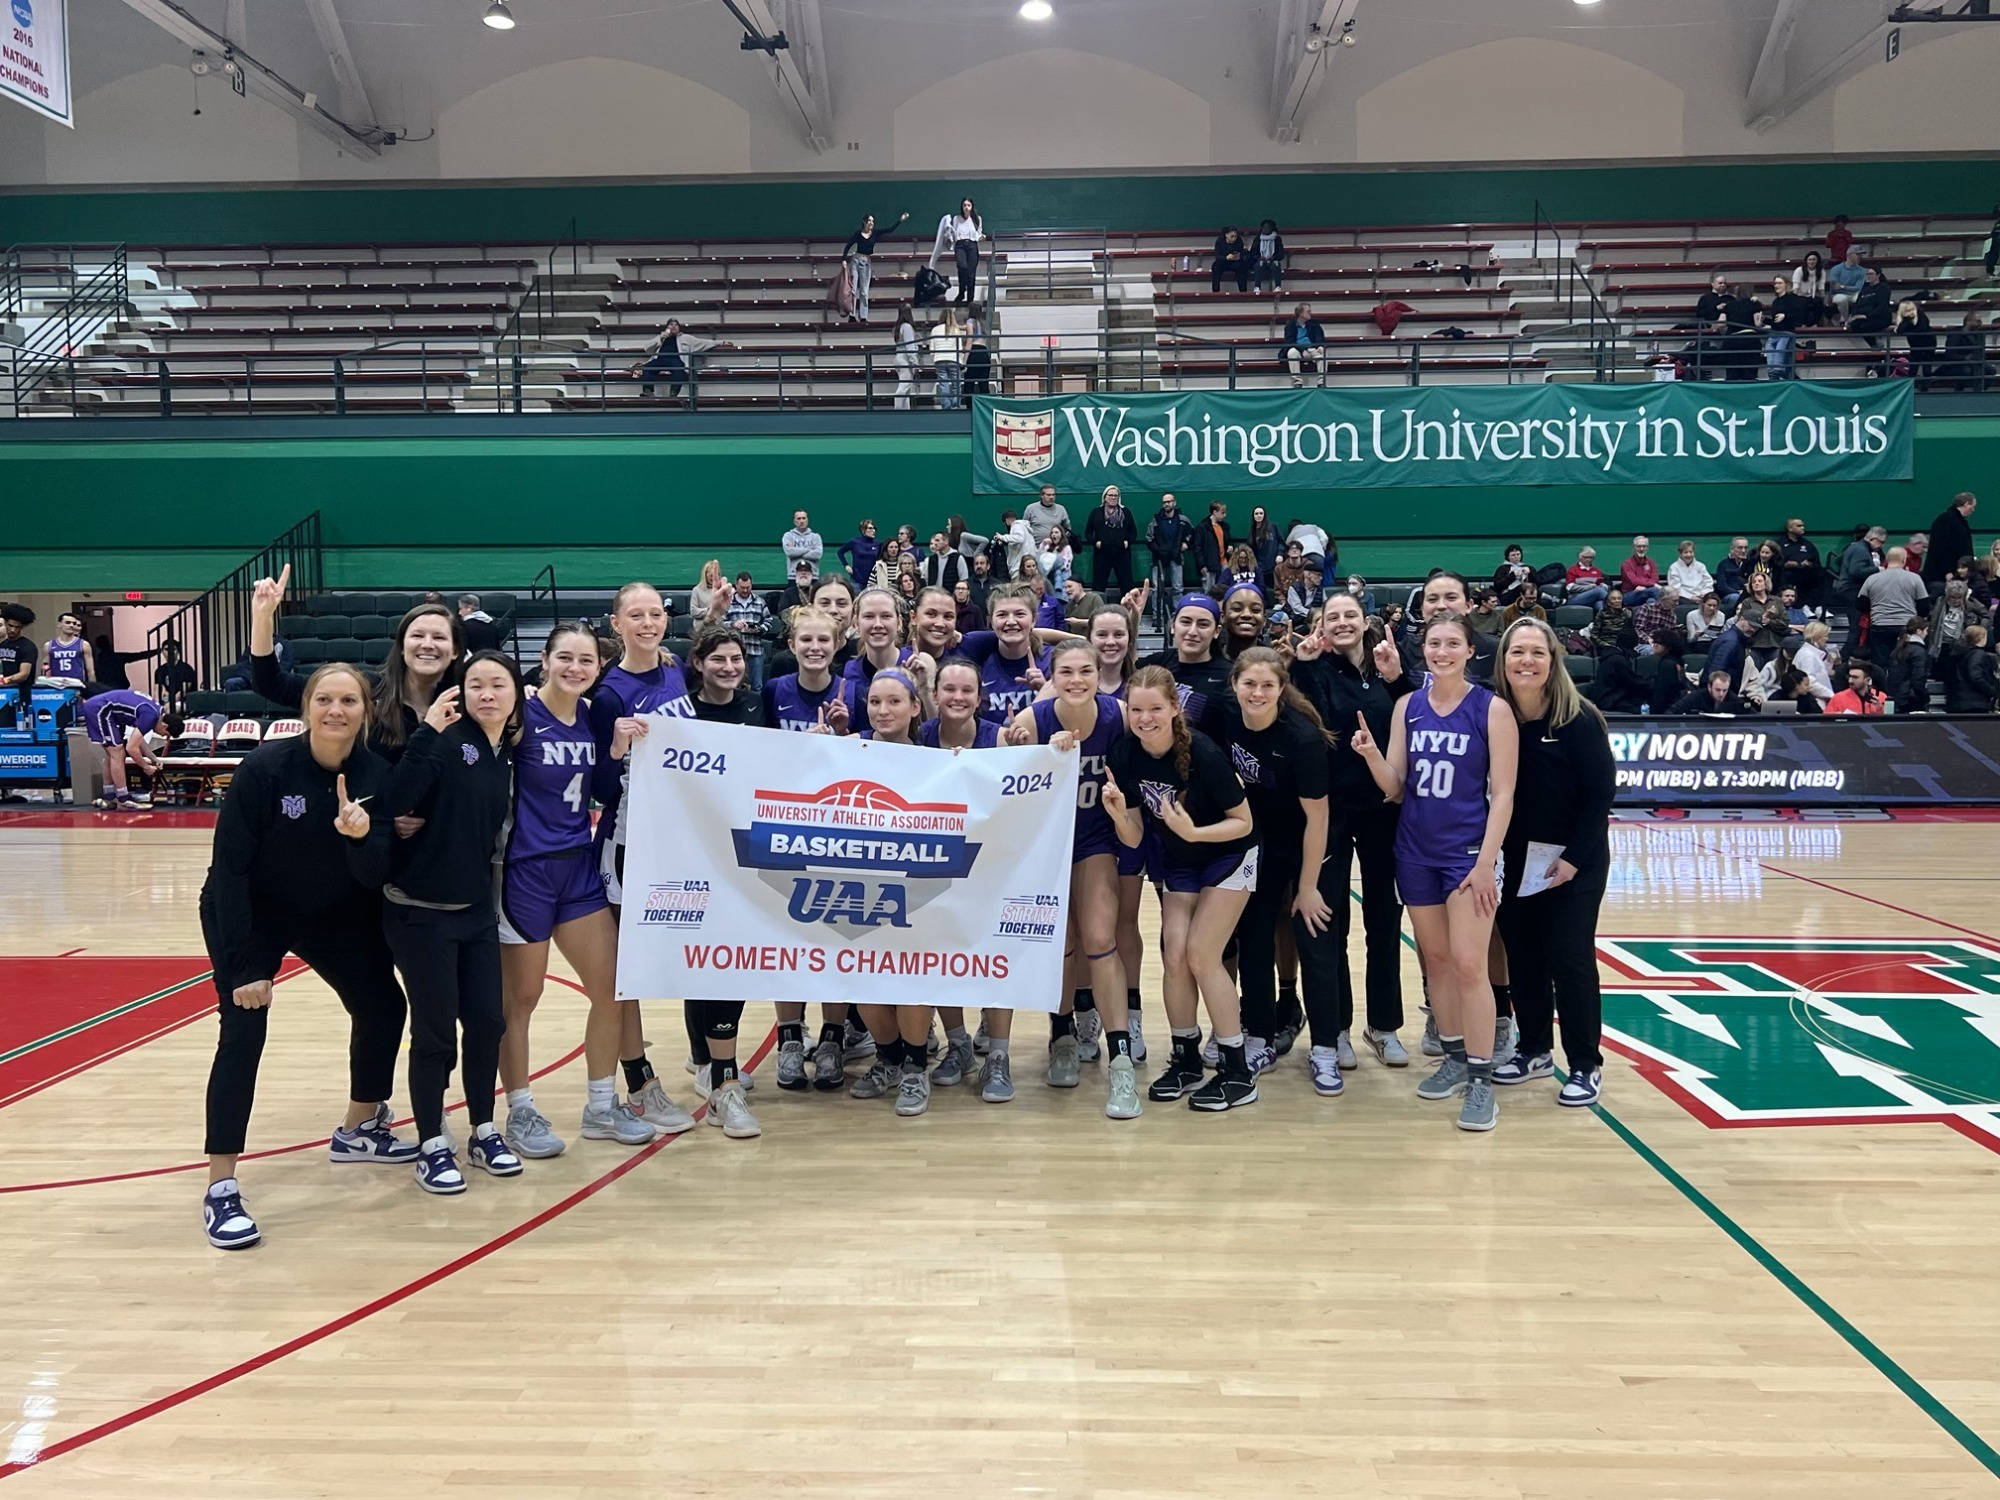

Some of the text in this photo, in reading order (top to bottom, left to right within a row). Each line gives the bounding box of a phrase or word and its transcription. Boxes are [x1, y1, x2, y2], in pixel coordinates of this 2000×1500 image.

[13, 28, 33, 48] 2016
[1889, 32, 1897, 60] E
[2, 45, 44, 77] NATIONAL
[0, 64, 49, 99] CHAMPIONS
[234, 69, 243, 93] B
[1061, 407, 1363, 477] Washington
[1369, 407, 1626, 471] University
[1636, 406, 1688, 457] in
[1233, 571, 1255, 581] NYU
[54, 650, 76, 658] NYU
[59, 659, 72, 671] 15
[185, 722, 208, 734] EARS
[226, 722, 254, 734] BEARS
[273, 722, 303, 734] BEARS
[541, 741, 596, 765] NYU
[1410, 730, 1470, 756] NYU
[1608, 733, 1766, 762] RY MONTH
[0, 755, 47, 764] WERADE
[662, 748, 727, 775] 2024
[1079, 755, 1107, 776] YU
[1001, 772, 1053, 796] 2024
[1415, 758, 1455, 799] 20
[1646, 769, 1701, 790] (WBB)
[1704, 770, 1719, 787] &
[1721, 770, 1787, 787] 7:30PM
[1790, 769, 1844, 790] (MBB)
[563, 773, 584, 813] 4
[757, 804, 964, 831] UNIVERSITY ATHLETIC ASSOCIATION
[770, 833, 949, 862] BASKETBALL
[683, 880, 710, 891] UAA
[646, 892, 710, 910] STRIVE
[788, 878, 912, 928] UAA
[1036, 894, 1059, 906] UAA
[643, 909, 705, 922] TOGETHER
[1001, 905, 1059, 923] STRIVE
[999, 921, 1055, 935] TOGETHER
[684, 945, 1009, 979] WOMEN'S CHAMPIONS
